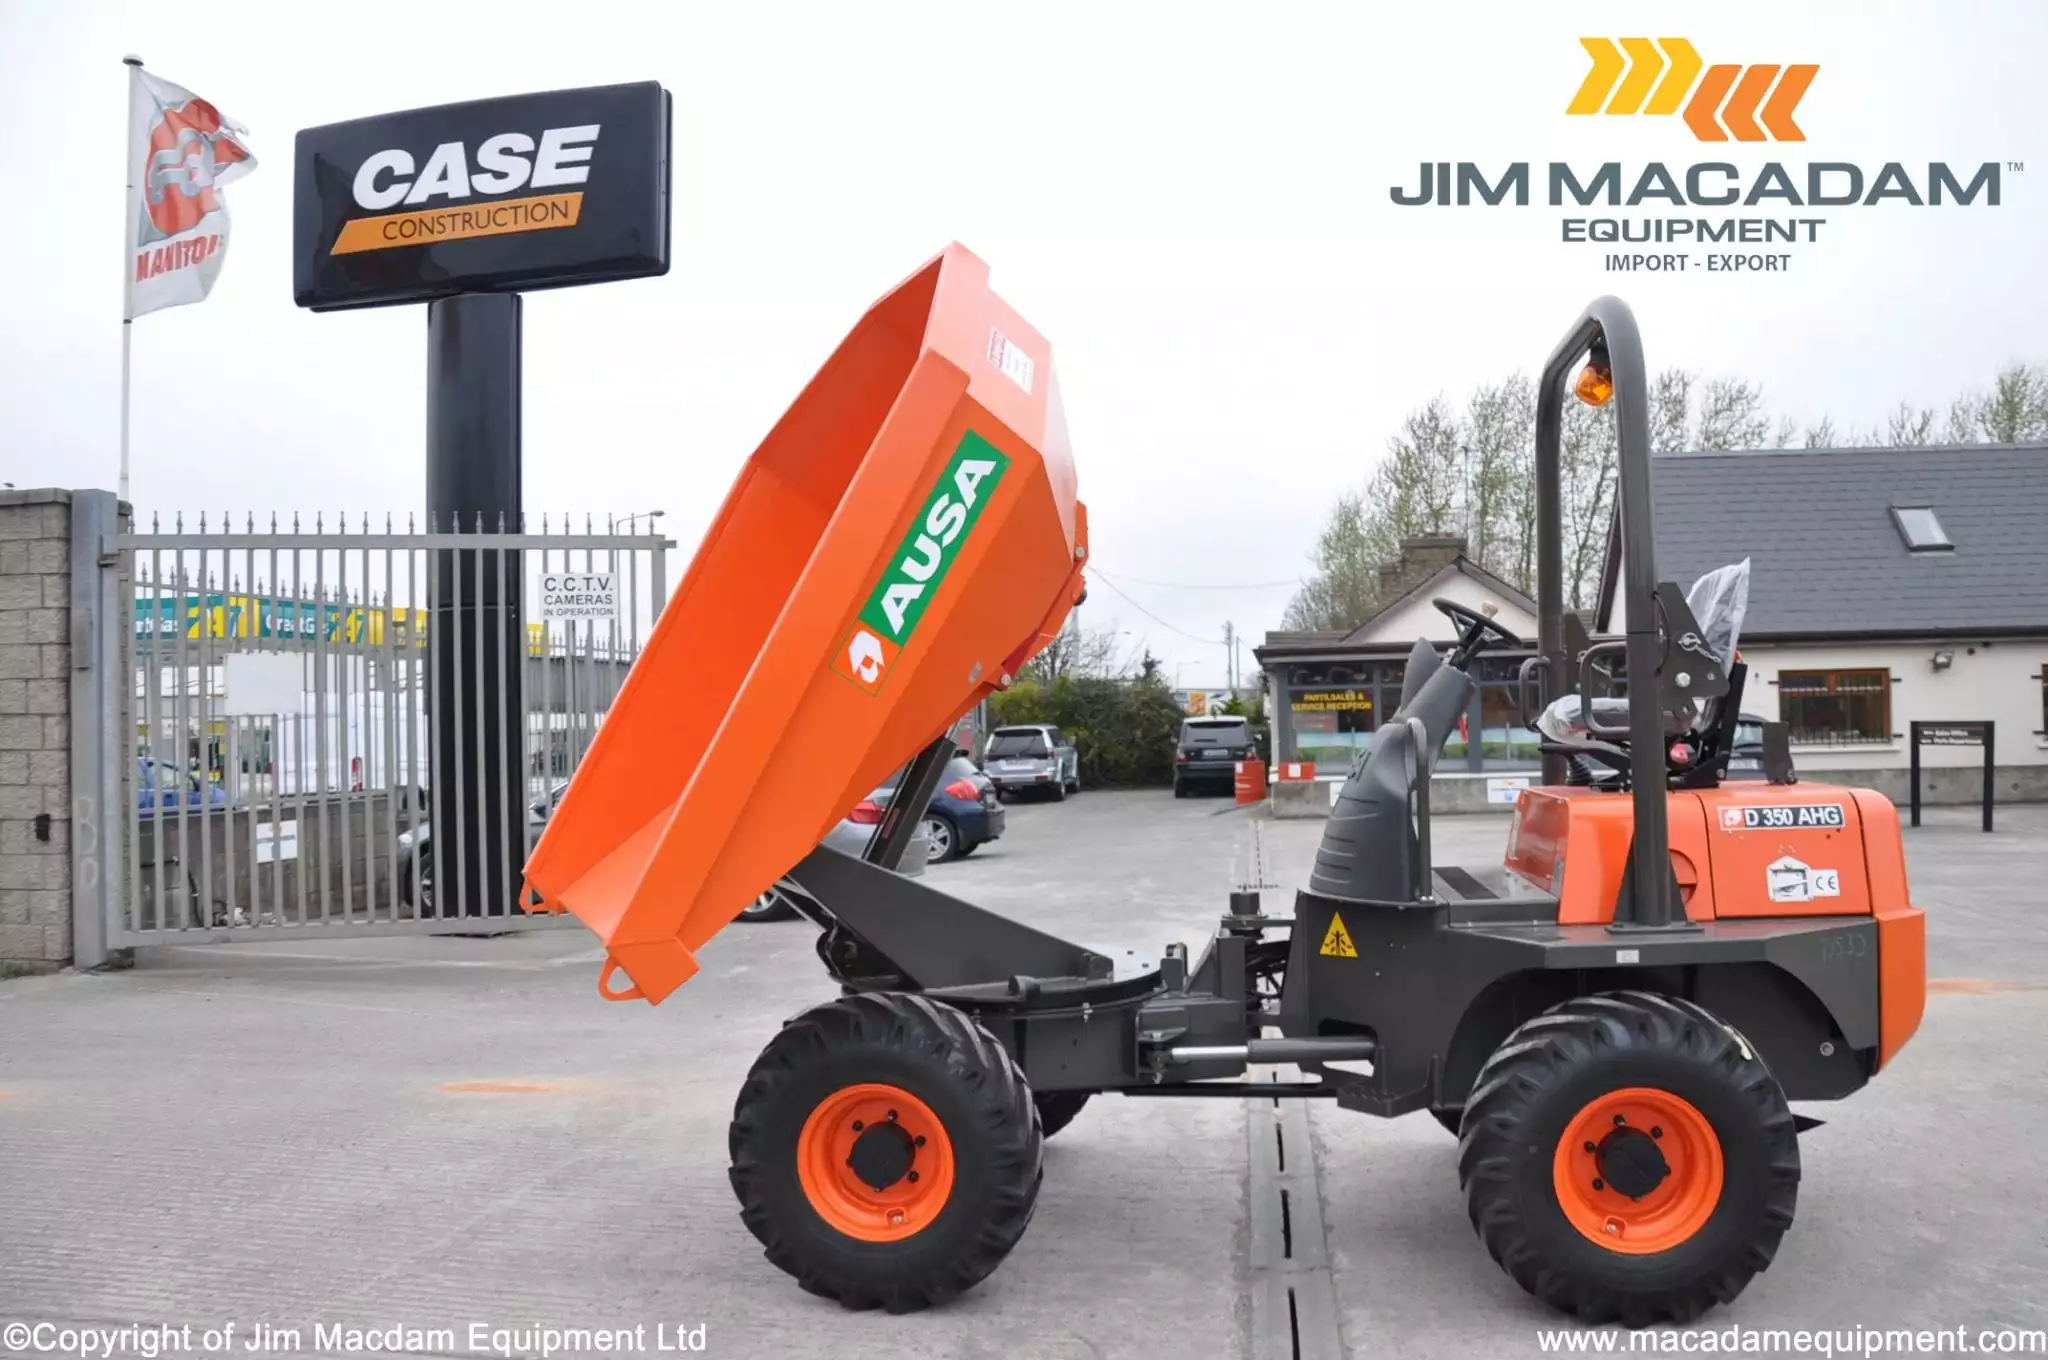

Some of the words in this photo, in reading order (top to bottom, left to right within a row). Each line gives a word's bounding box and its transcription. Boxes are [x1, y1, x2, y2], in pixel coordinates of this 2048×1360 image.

[352, 123, 601, 210] CASE
[382, 200, 569, 241] CONSTRUCTION
[881, 459, 996, 635] AUSA
[544, 576, 614, 592] C.C.T.V.
[543, 594, 614, 606] CAMERAS
[543, 607, 554, 616] IN
[556, 607, 614, 617] OPERATION
[1326, 701, 1373, 711] RECEPTION
[1745, 809, 1760, 827] D
[1762, 808, 1794, 826] 350
[1797, 806, 1840, 825] AHG
